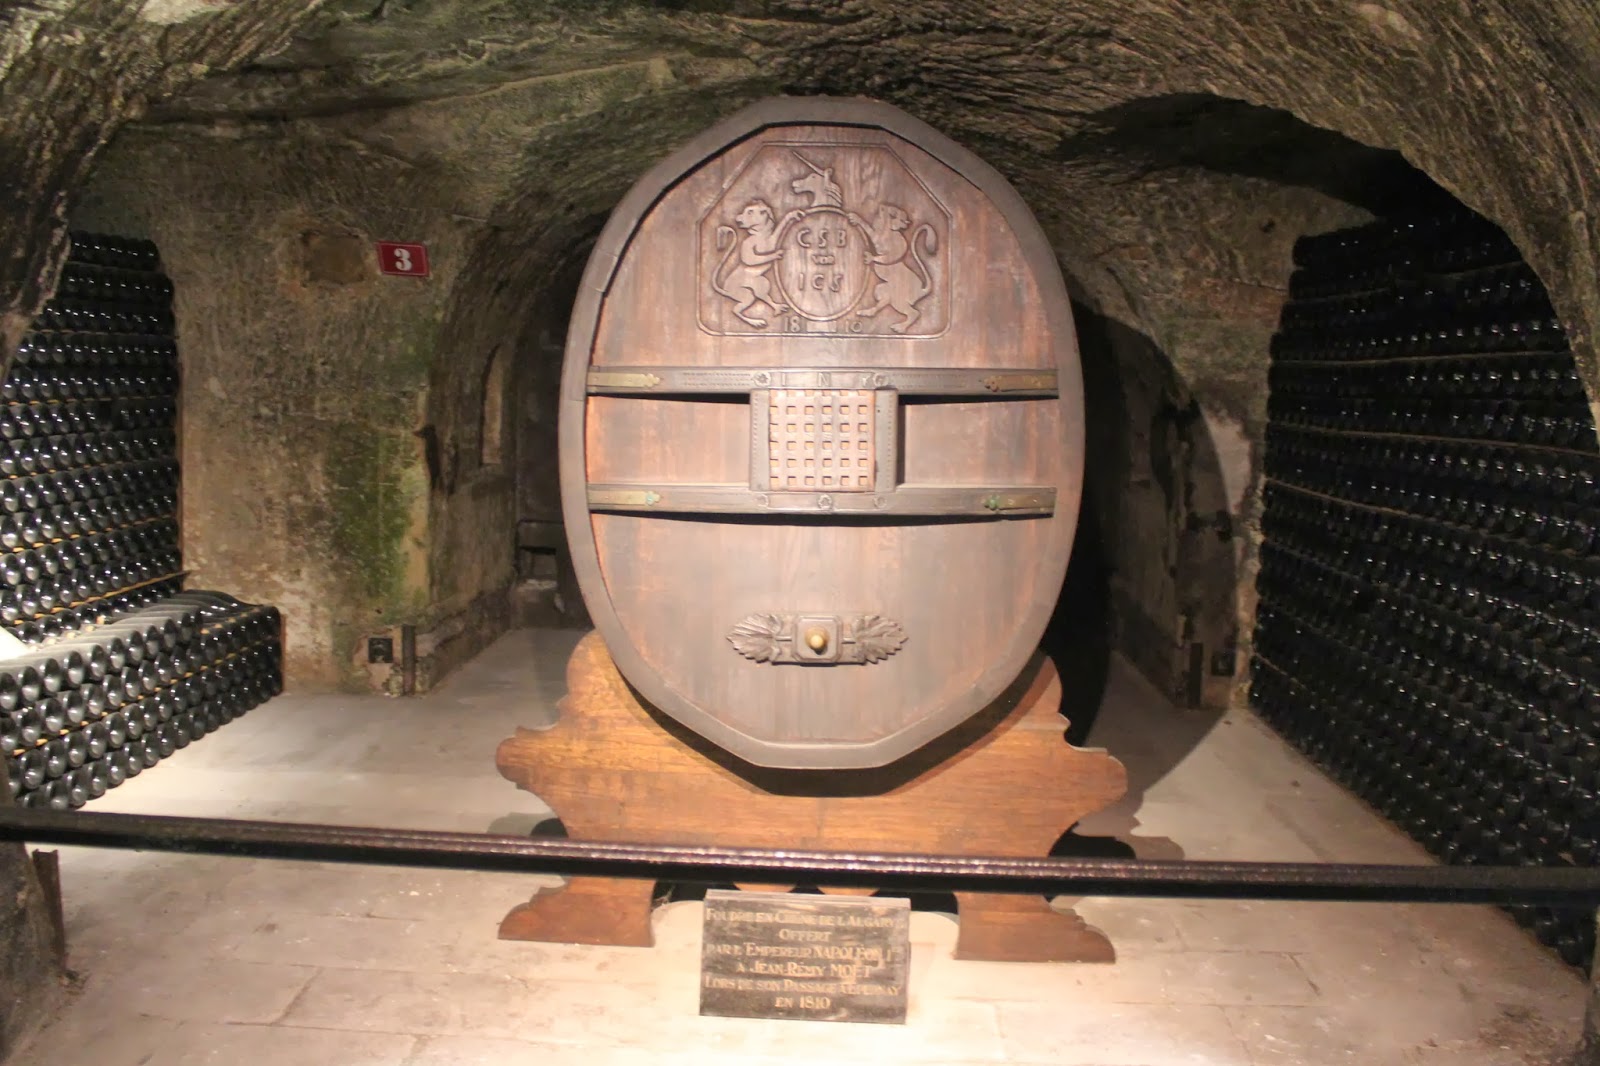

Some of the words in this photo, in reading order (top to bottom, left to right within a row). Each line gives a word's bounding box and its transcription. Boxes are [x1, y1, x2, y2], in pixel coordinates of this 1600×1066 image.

[394, 248, 413, 271] 3
[778, 928, 832, 942] OFFERT
[774, 997, 793, 1008] EN
[799, 996, 831, 1009] 1810
